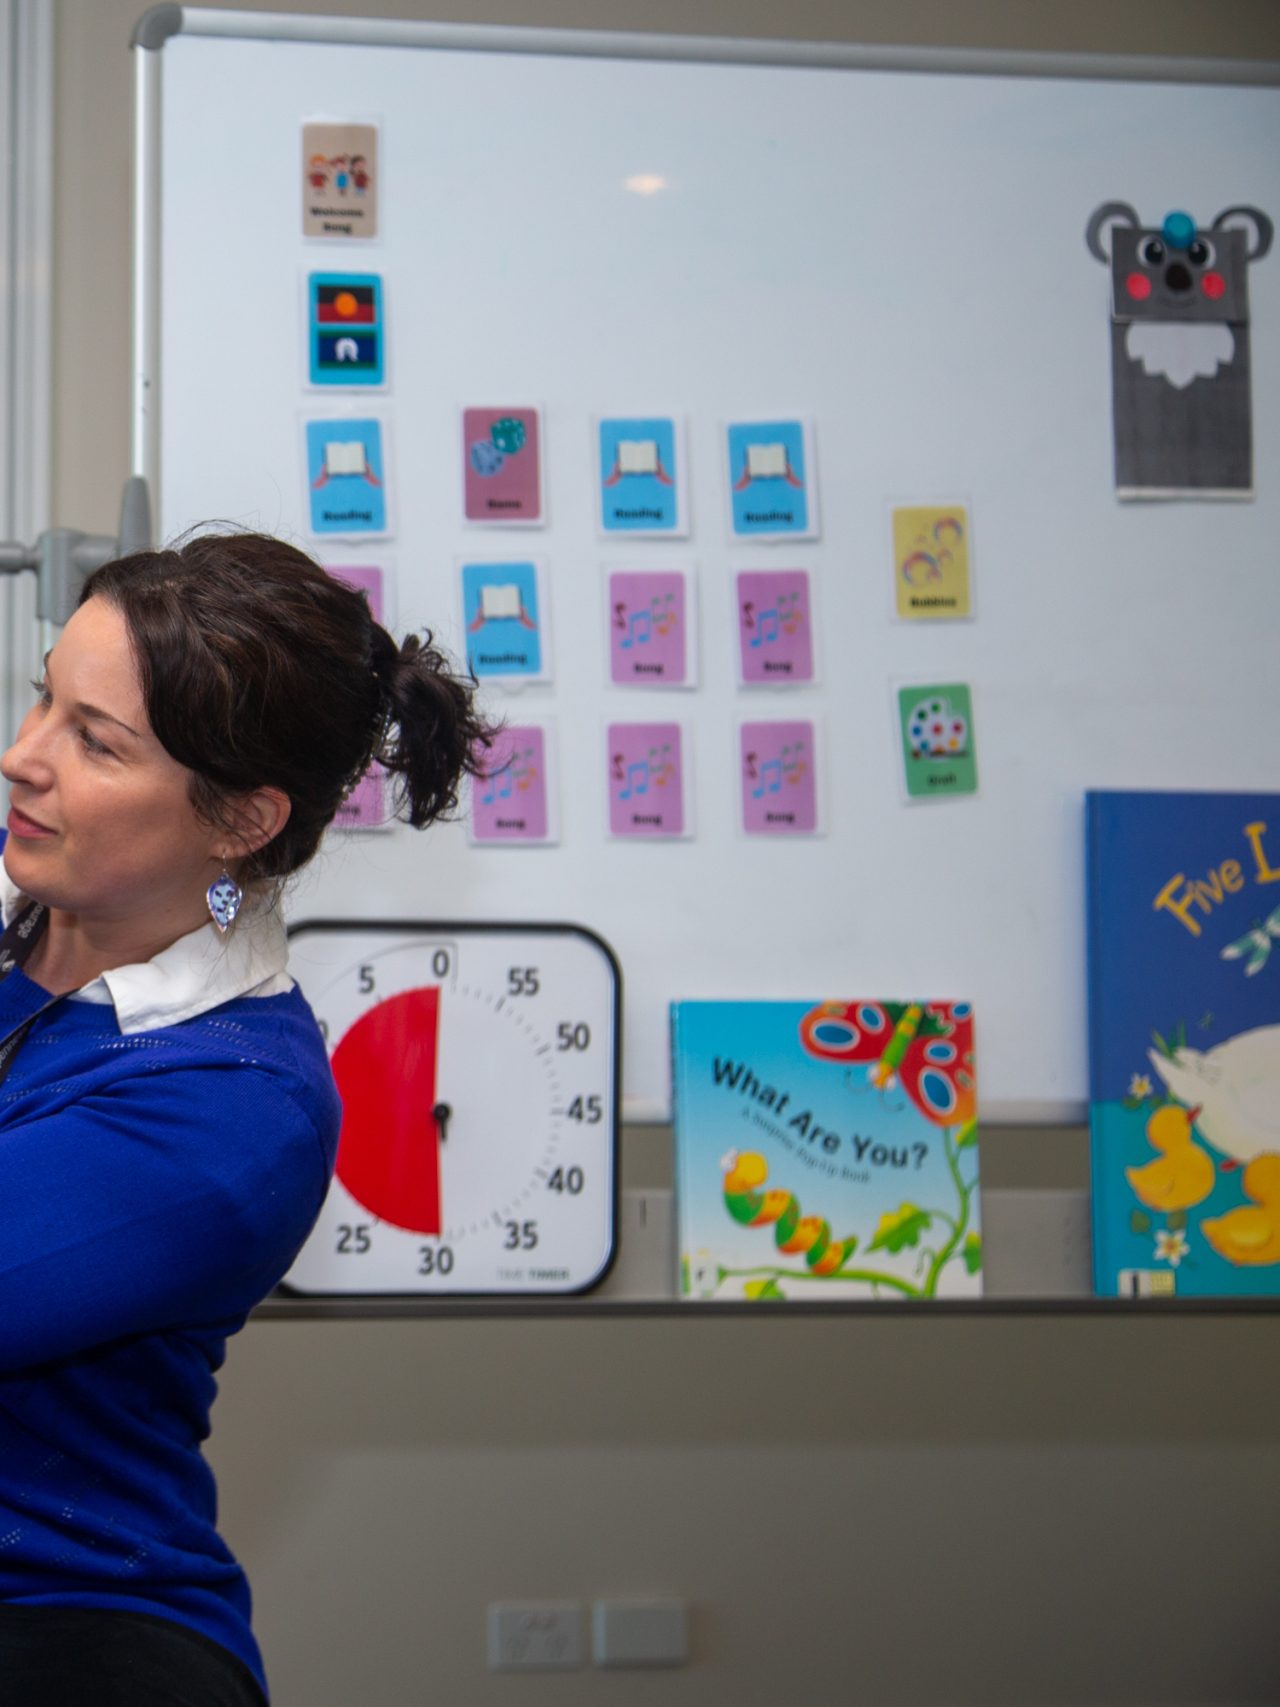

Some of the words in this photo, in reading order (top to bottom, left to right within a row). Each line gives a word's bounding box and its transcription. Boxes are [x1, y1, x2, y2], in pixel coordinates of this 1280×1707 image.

[323, 223, 353, 234] Song
[324, 510, 372, 521] Reading
[615, 508, 663, 520] Reading
[745, 511, 793, 523] Reading
[479, 653, 527, 665] Reading
[635, 663, 663, 675] Song
[764, 661, 792, 673] Song
[496, 818, 525, 830] Song
[632, 814, 662, 827] Song
[766, 812, 795, 825] Song
[1153, 858, 1245, 938] Five
[17, 902, 44, 938] ourage
[433, 949, 449, 977] 0
[359, 966, 374, 994] 5
[508, 968, 539, 996] 55
[558, 1023, 589, 1051] 50
[568, 1095, 602, 1124] 45
[712, 1056, 791, 1115] What
[789, 1109, 841, 1153] Are
[851, 1132, 929, 1170] You?
[548, 1167, 584, 1195] 40
[336, 1225, 371, 1254] 25
[504, 1221, 538, 1250] 35
[418, 1247, 453, 1275] 30
